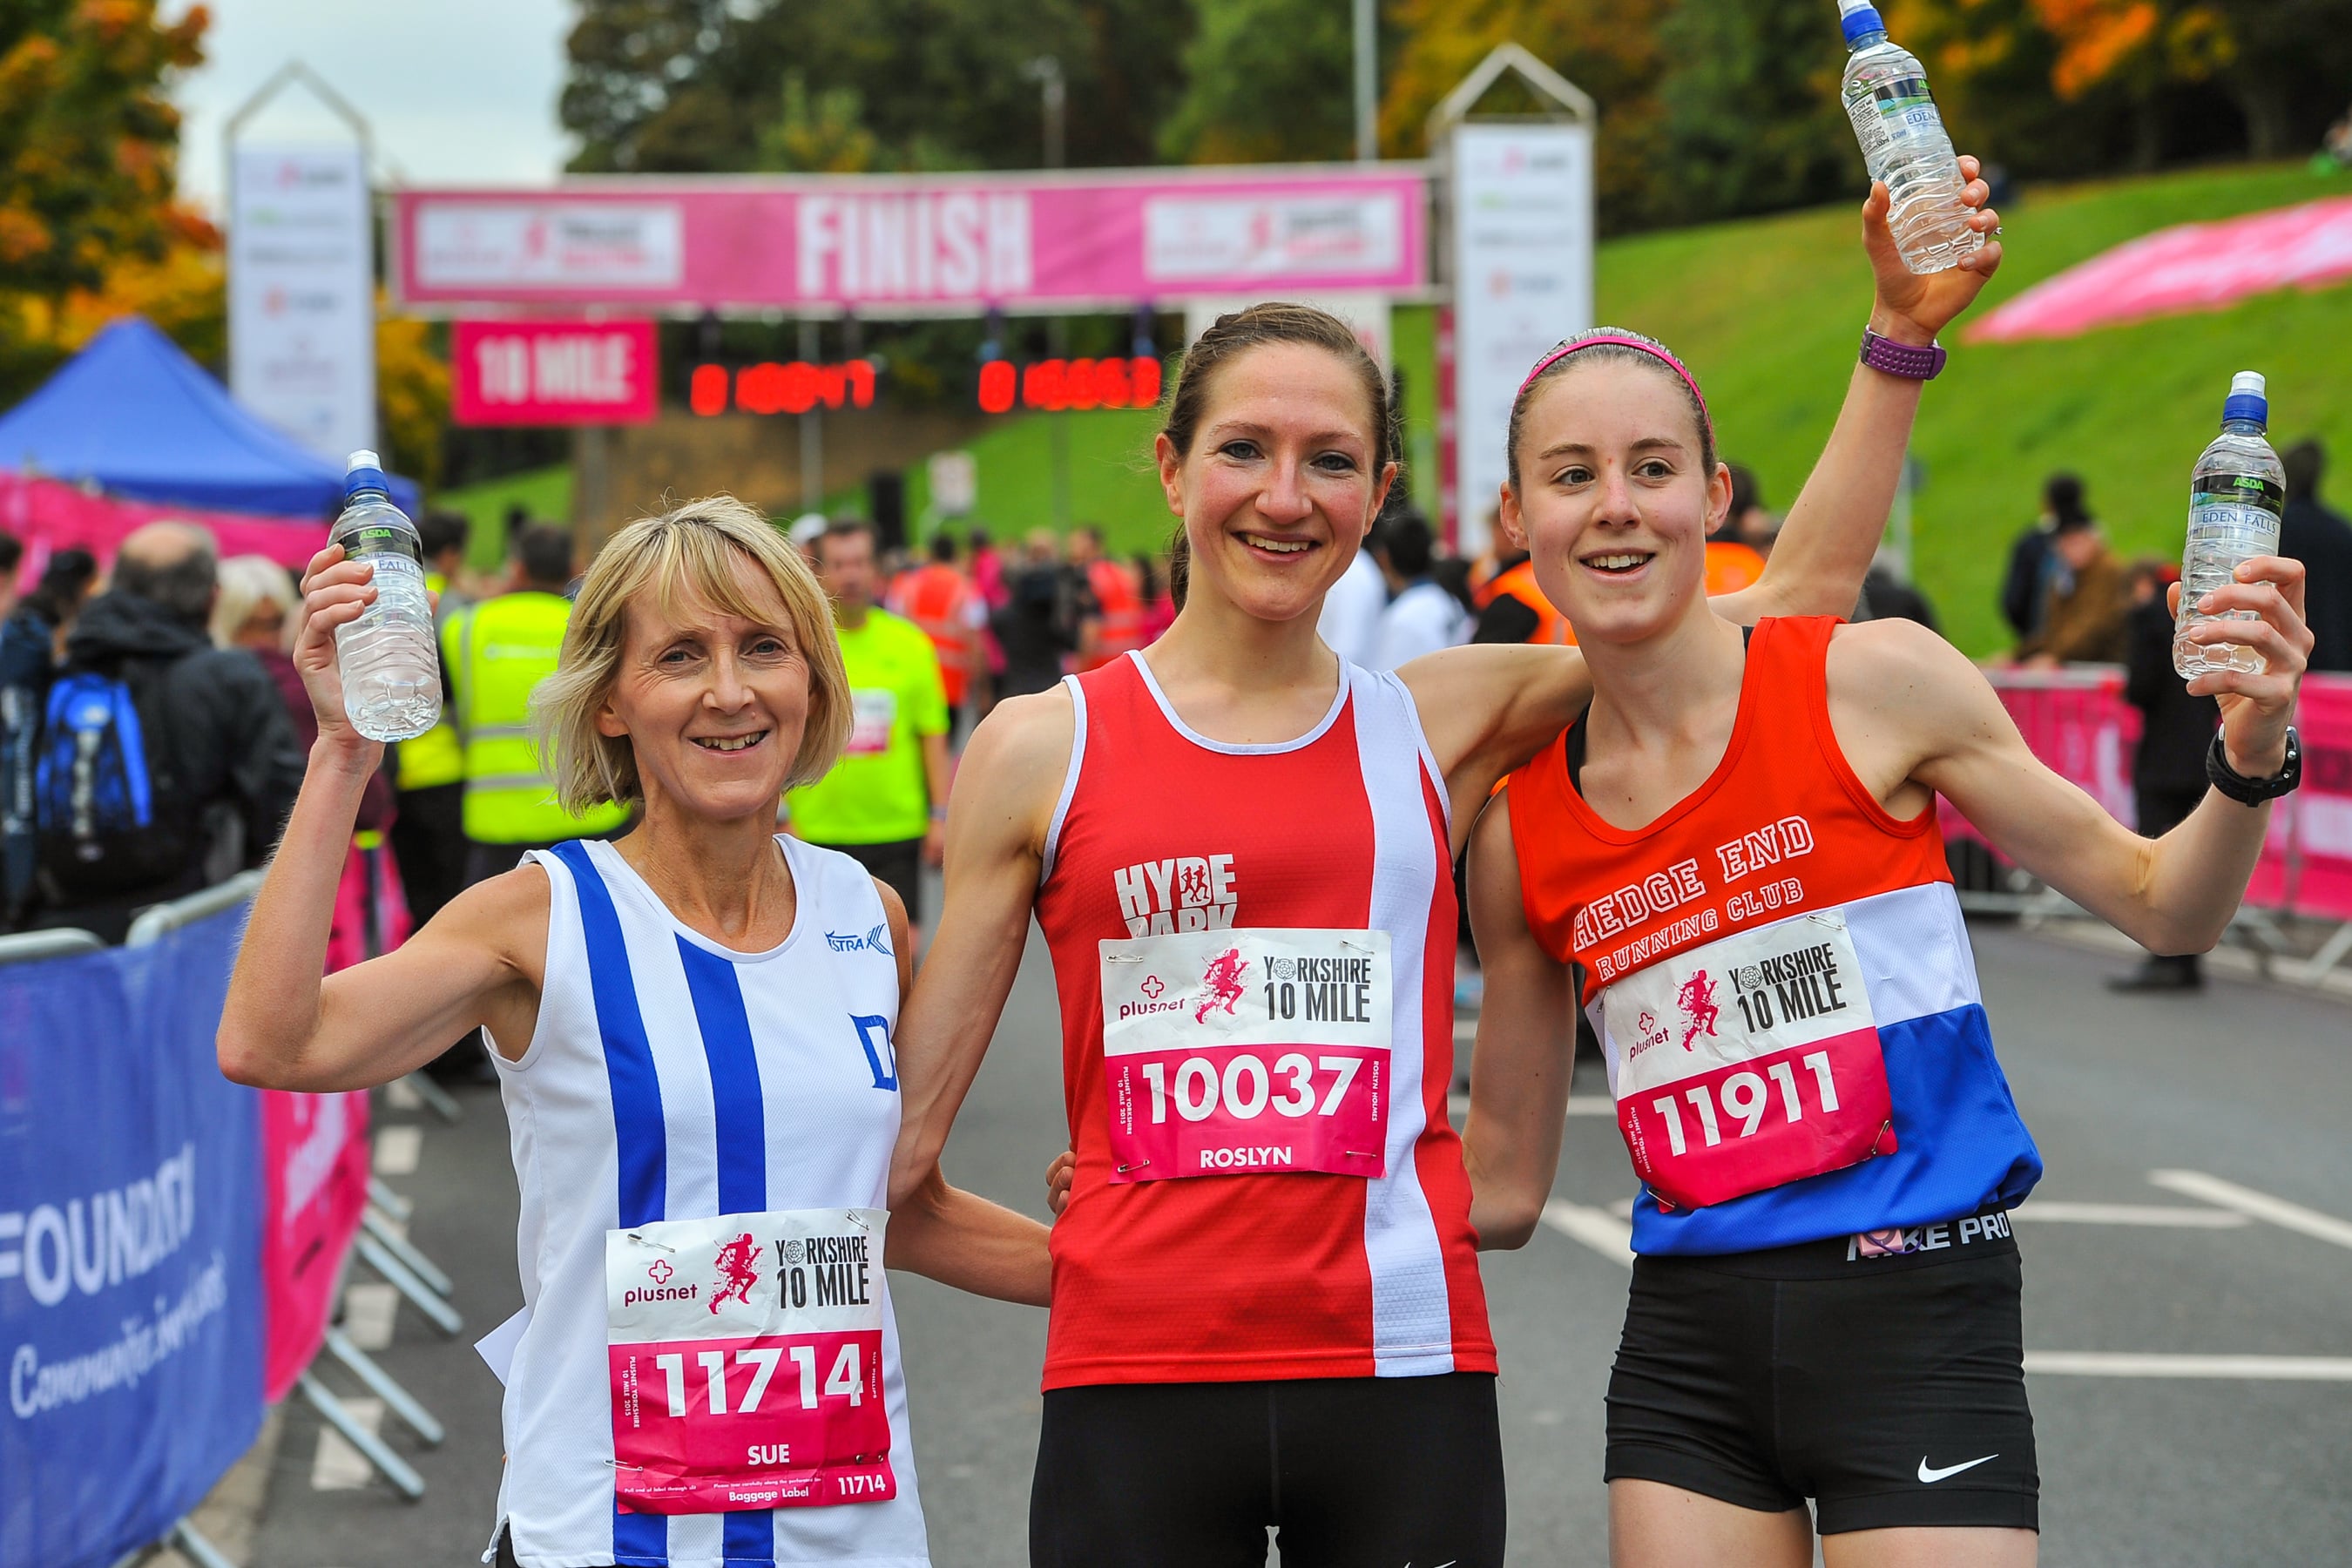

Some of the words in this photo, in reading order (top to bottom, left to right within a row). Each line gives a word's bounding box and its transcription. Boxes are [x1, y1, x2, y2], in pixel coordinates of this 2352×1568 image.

[798, 193, 1033, 297] FINISH
[475, 334, 529, 405] 10
[532, 332, 638, 404] MILE
[2233, 476, 2264, 491] ASDA
[359, 529, 393, 540] ASDA
[2202, 512, 2237, 524] EDEN
[2244, 514, 2276, 534] FALLS
[378, 559, 416, 576] FALLS
[1113, 854, 1238, 921] HYDE
[1572, 857, 1707, 953] HEDGE
[1715, 814, 1815, 884] END
[1595, 908, 1719, 983] RUNNING
[1726, 877, 1804, 923] CLUB
[1263, 956, 1371, 983] YORKSHIRE
[1727, 943, 1837, 994] YORKSHIRE
[1119, 998, 1185, 1020] plusnet
[1264, 983, 1295, 1021] 10
[1307, 983, 1370, 1023] MILE
[1737, 990, 1774, 1033] 10
[1775, 969, 1847, 1024] MILE
[1629, 1028, 1670, 1063] plusnet
[1118, 1079, 1124, 1088] 10
[1122, 1065, 1131, 1095] PLUSNET
[1142, 1053, 1364, 1124] 10037
[1652, 1051, 1840, 1157] 11911
[1200, 1146, 1292, 1168] ROSLYN
[775, 1235, 868, 1267] YORKSHIRE
[624, 1282, 698, 1307] plusnet
[777, 1267, 807, 1308] 10
[815, 1263, 869, 1307] MILE
[622, 1369, 629, 1378] 10
[629, 1355, 638, 1387] PLUSNET
[656, 1343, 864, 1417] 11714
[632, 1389, 640, 1428] YORKSHIRE
[747, 1443, 790, 1465] SUE
[728, 1490, 778, 1503] Baggage
[781, 1486, 809, 1497] Label
[838, 1474, 886, 1496] 11714
